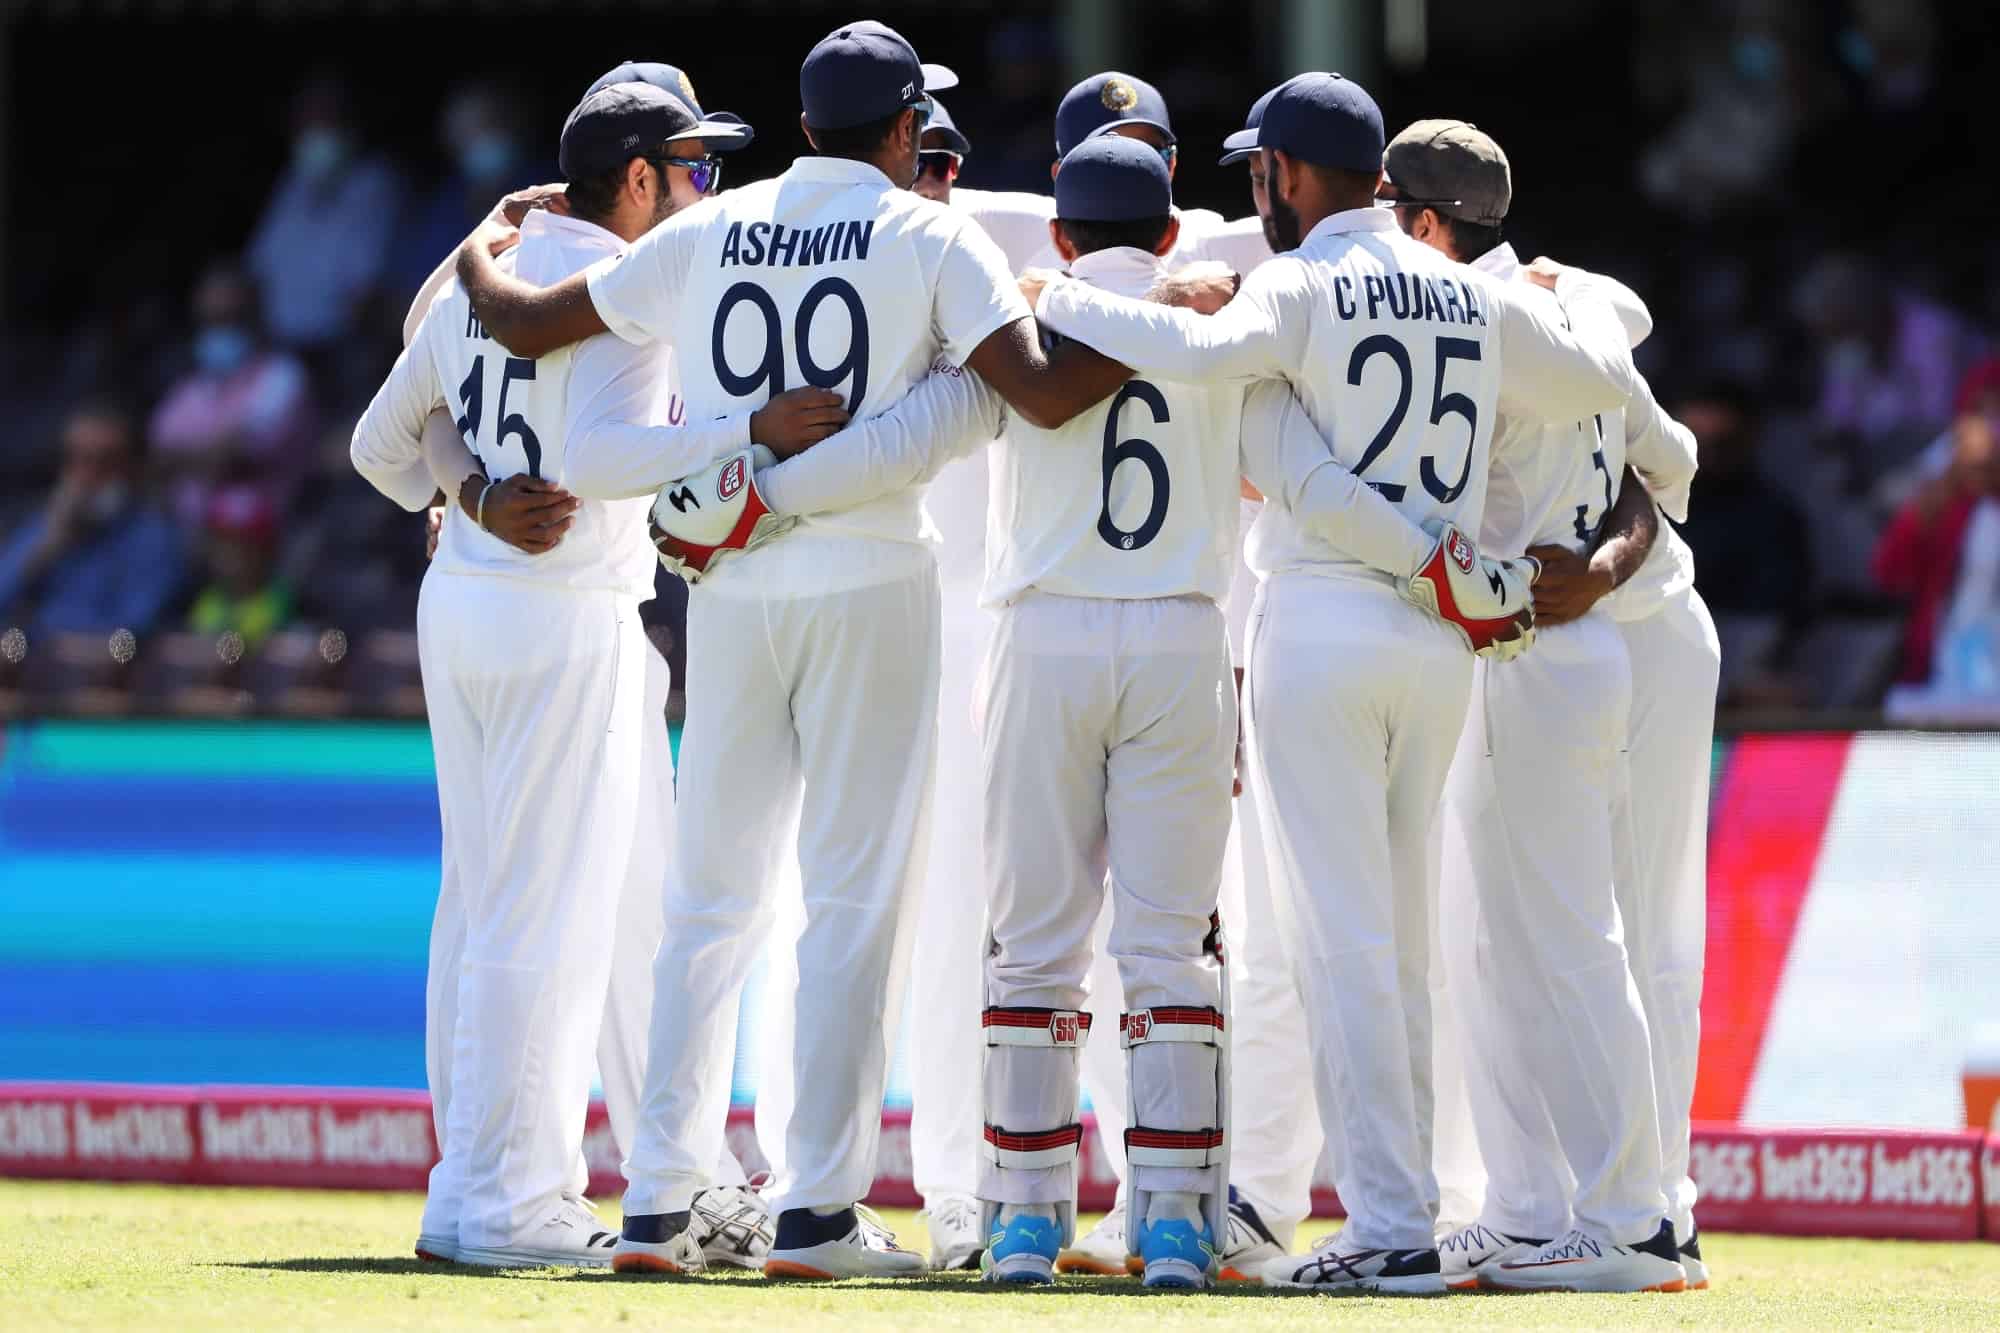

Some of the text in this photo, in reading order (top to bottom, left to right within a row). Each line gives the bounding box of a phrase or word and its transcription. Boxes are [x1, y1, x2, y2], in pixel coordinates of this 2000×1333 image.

[901, 80, 915, 100] 271
[720, 220, 874, 267] ASHWIN
[1334, 272, 1487, 326] C PUJARA
[712, 276, 869, 420] 99
[1347, 333, 1481, 503] 25
[1097, 379, 1170, 550] 6
[1056, 1016, 1076, 1042] SS
[1127, 1014, 1147, 1040] SS
[1761, 1139, 1867, 1205] bet365
[1871, 1140, 1973, 1206] bet365
